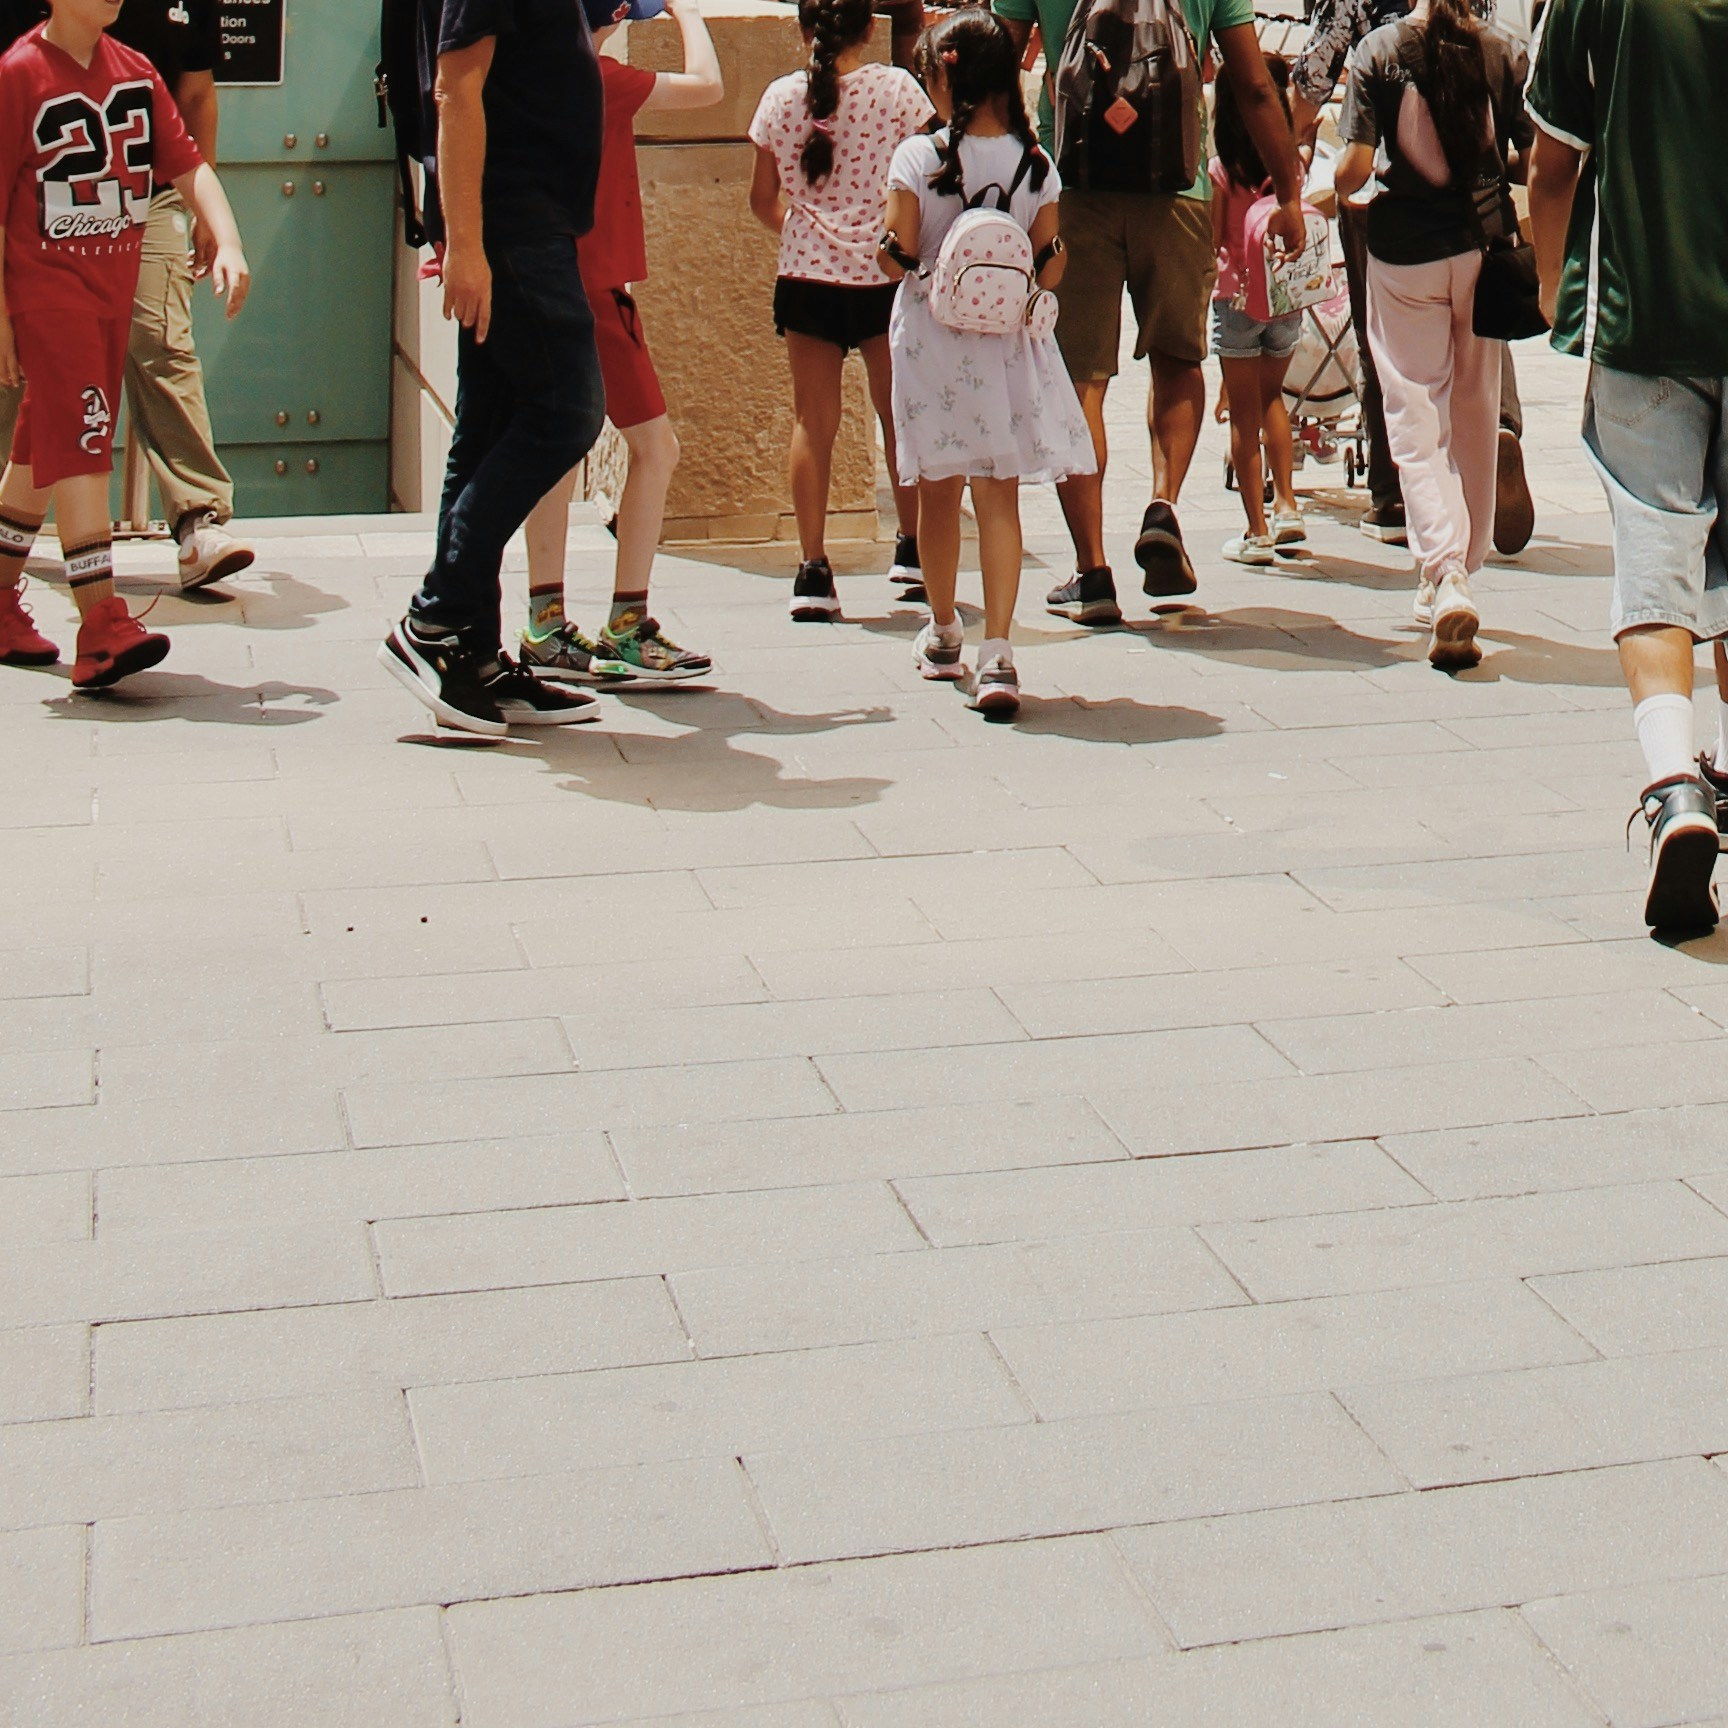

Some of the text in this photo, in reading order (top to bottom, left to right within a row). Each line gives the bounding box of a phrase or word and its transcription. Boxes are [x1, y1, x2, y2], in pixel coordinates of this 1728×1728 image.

[220, 16, 247, 28] tion
[33, 79, 154, 232] 23
[49, 212, 134, 240] Chicago
[70, 554, 111, 572] BUFFA
